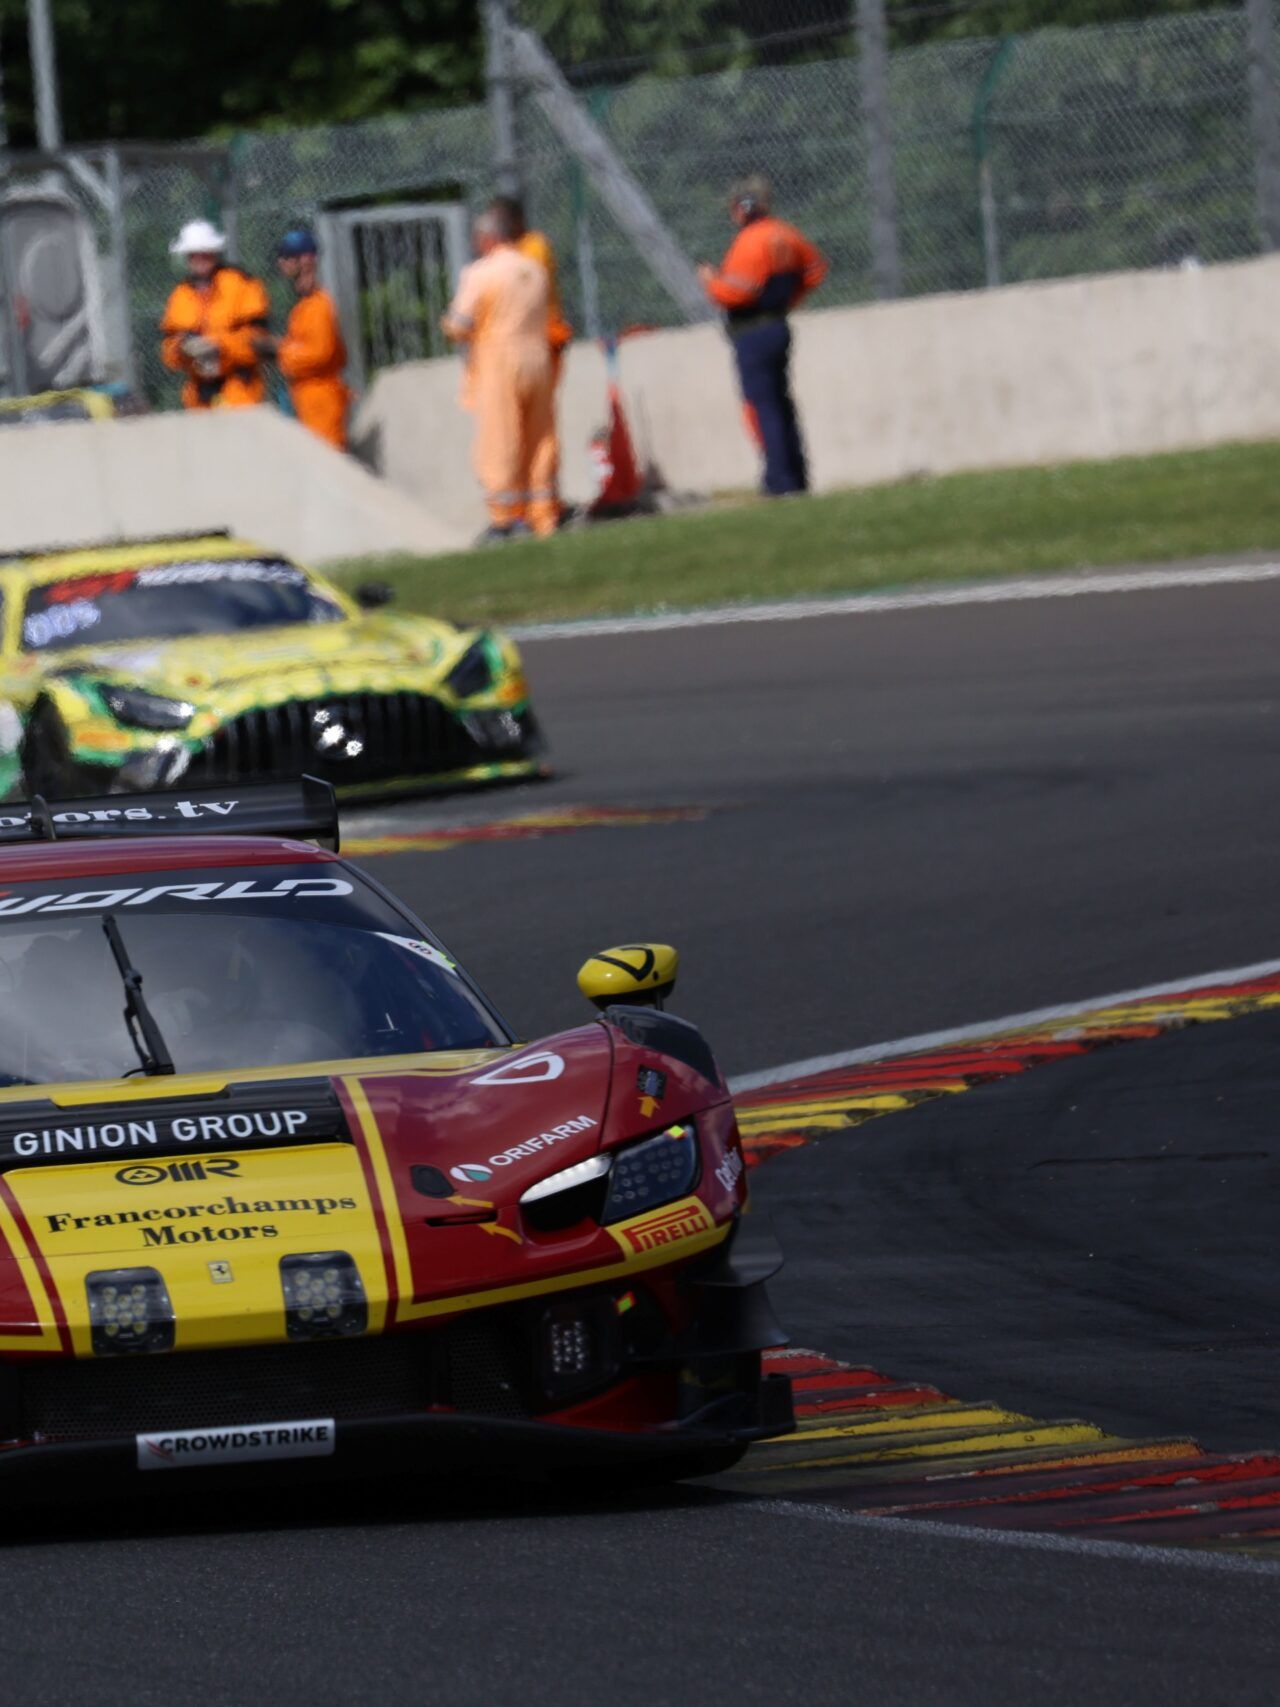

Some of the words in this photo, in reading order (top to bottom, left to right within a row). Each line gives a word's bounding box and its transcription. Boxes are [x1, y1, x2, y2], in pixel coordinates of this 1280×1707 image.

[13, 1119, 158, 1156] GINION
[170, 1110, 308, 1141] GROUP
[489, 1115, 598, 1167] ORIFARM
[45, 1195, 357, 1233] Francorchamps
[138, 1221, 280, 1247] Motors
[621, 1204, 710, 1254] PIRELLI
[159, 1425, 329, 1453] CROWDSTRIKE
